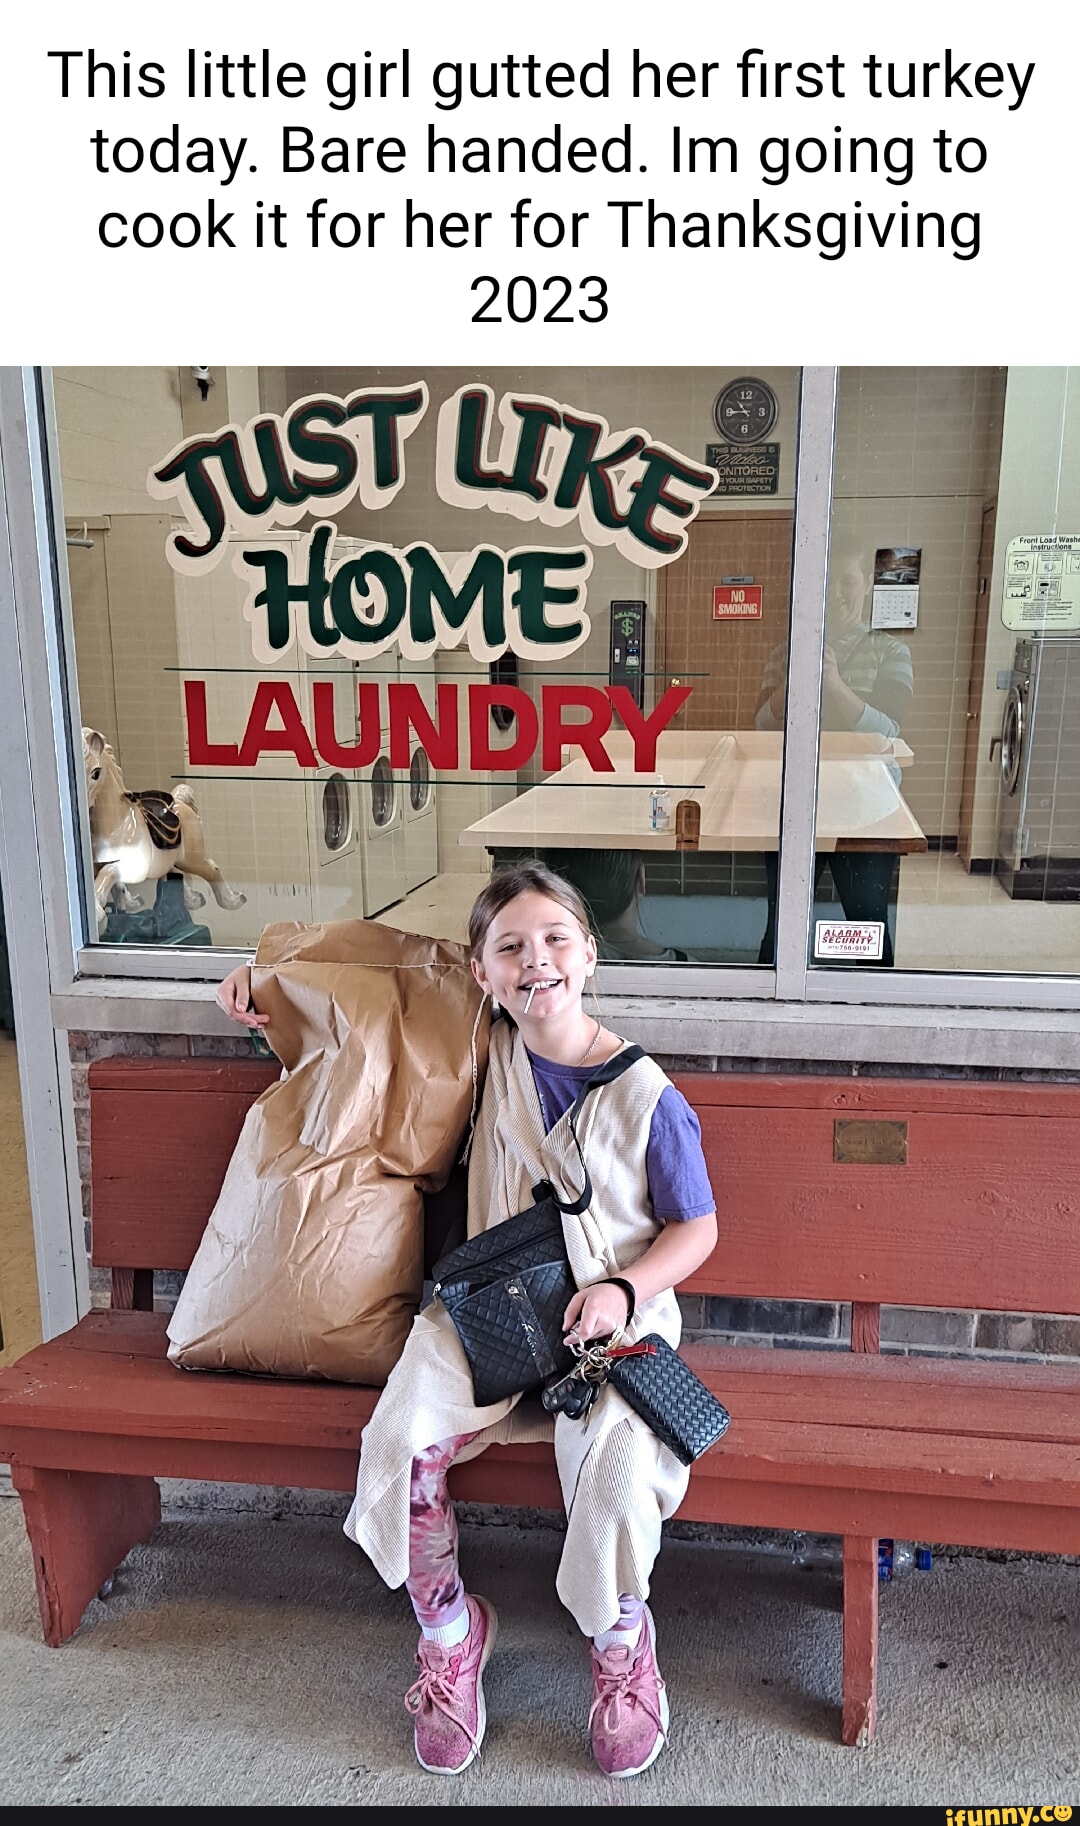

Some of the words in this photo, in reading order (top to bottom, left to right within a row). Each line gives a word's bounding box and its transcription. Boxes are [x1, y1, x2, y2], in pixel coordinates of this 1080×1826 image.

[740, 390, 753, 400] 12
[758, 407, 766, 417] 3
[741, 424, 748, 434] 6
[730, 446, 767, 454] BUSINESS
[715, 453, 770, 466] Video
[153, 386, 424, 559] JUST
[453, 386, 716, 557] LIKE
[717, 466, 776, 476] ONITORED
[1039, 536, 1057, 544] Load
[242, 526, 587, 650] HOME
[731, 589, 746, 603] NO
[718, 603, 758, 615] SMOKING
[184, 680, 694, 773] LAUNDRY
[823, 929, 862, 937] ALARM
[822, 936, 874, 945] SECURITY
